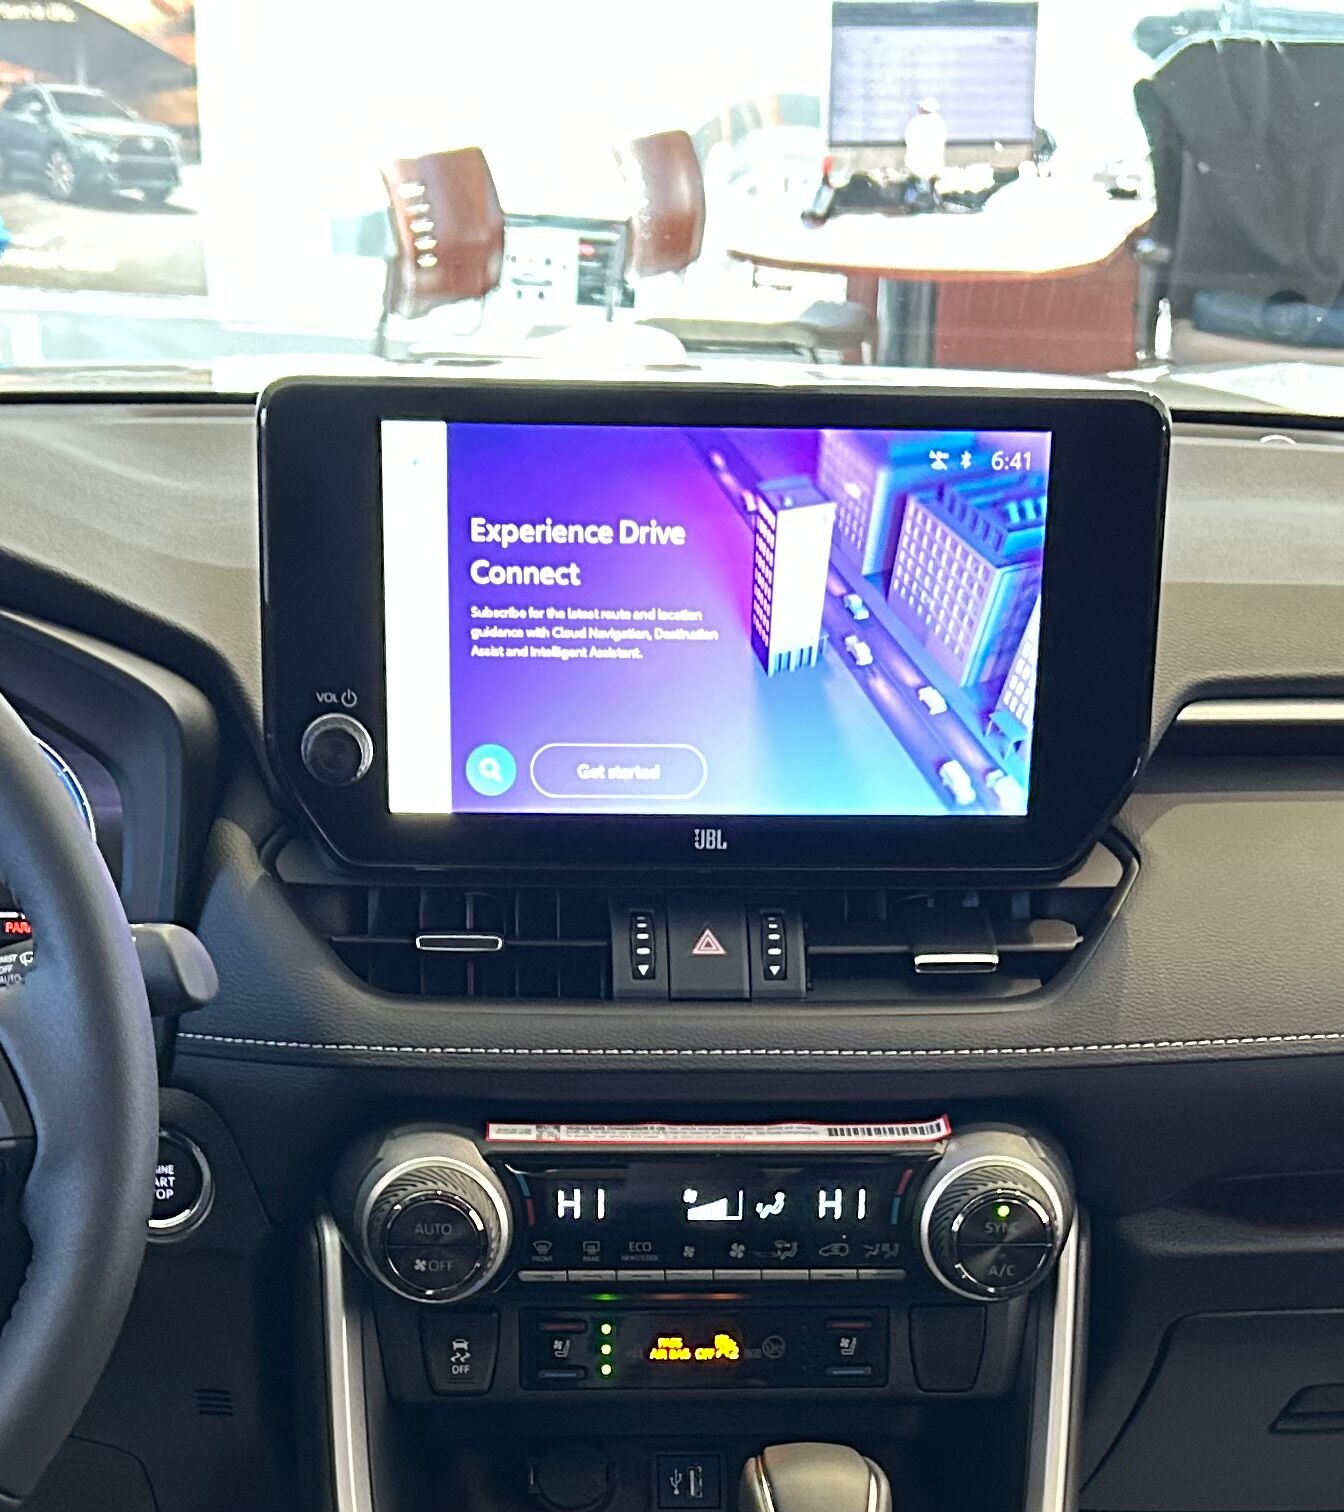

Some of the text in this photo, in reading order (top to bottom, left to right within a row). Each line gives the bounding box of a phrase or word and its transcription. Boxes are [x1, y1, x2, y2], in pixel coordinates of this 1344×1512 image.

[991, 450, 1032, 471] 6:41
[470, 517, 687, 548] Experience Drive
[469, 559, 582, 587] Connect
[470, 605, 704, 622] Subscribe for the latest route and location
[470, 625, 720, 643] guidance with Cloud Navigation, Destination
[470, 645, 644, 661] Assist and Intelligent Assistant.
[316, 691, 338, 703] VOL
[576, 763, 661, 781] Get started
[693, 828, 728, 850] JBL
[4, 921, 33, 934] PAR
[156, 1188, 174, 1200] OP
[414, 1222, 453, 1237] AUTO
[984, 1221, 1020, 1234] SYNC
[628, 1241, 652, 1253] ECO
[428, 1260, 454, 1272] OFF
[988, 1263, 1016, 1278] A/C
[451, 1364, 470, 1375] OFF
